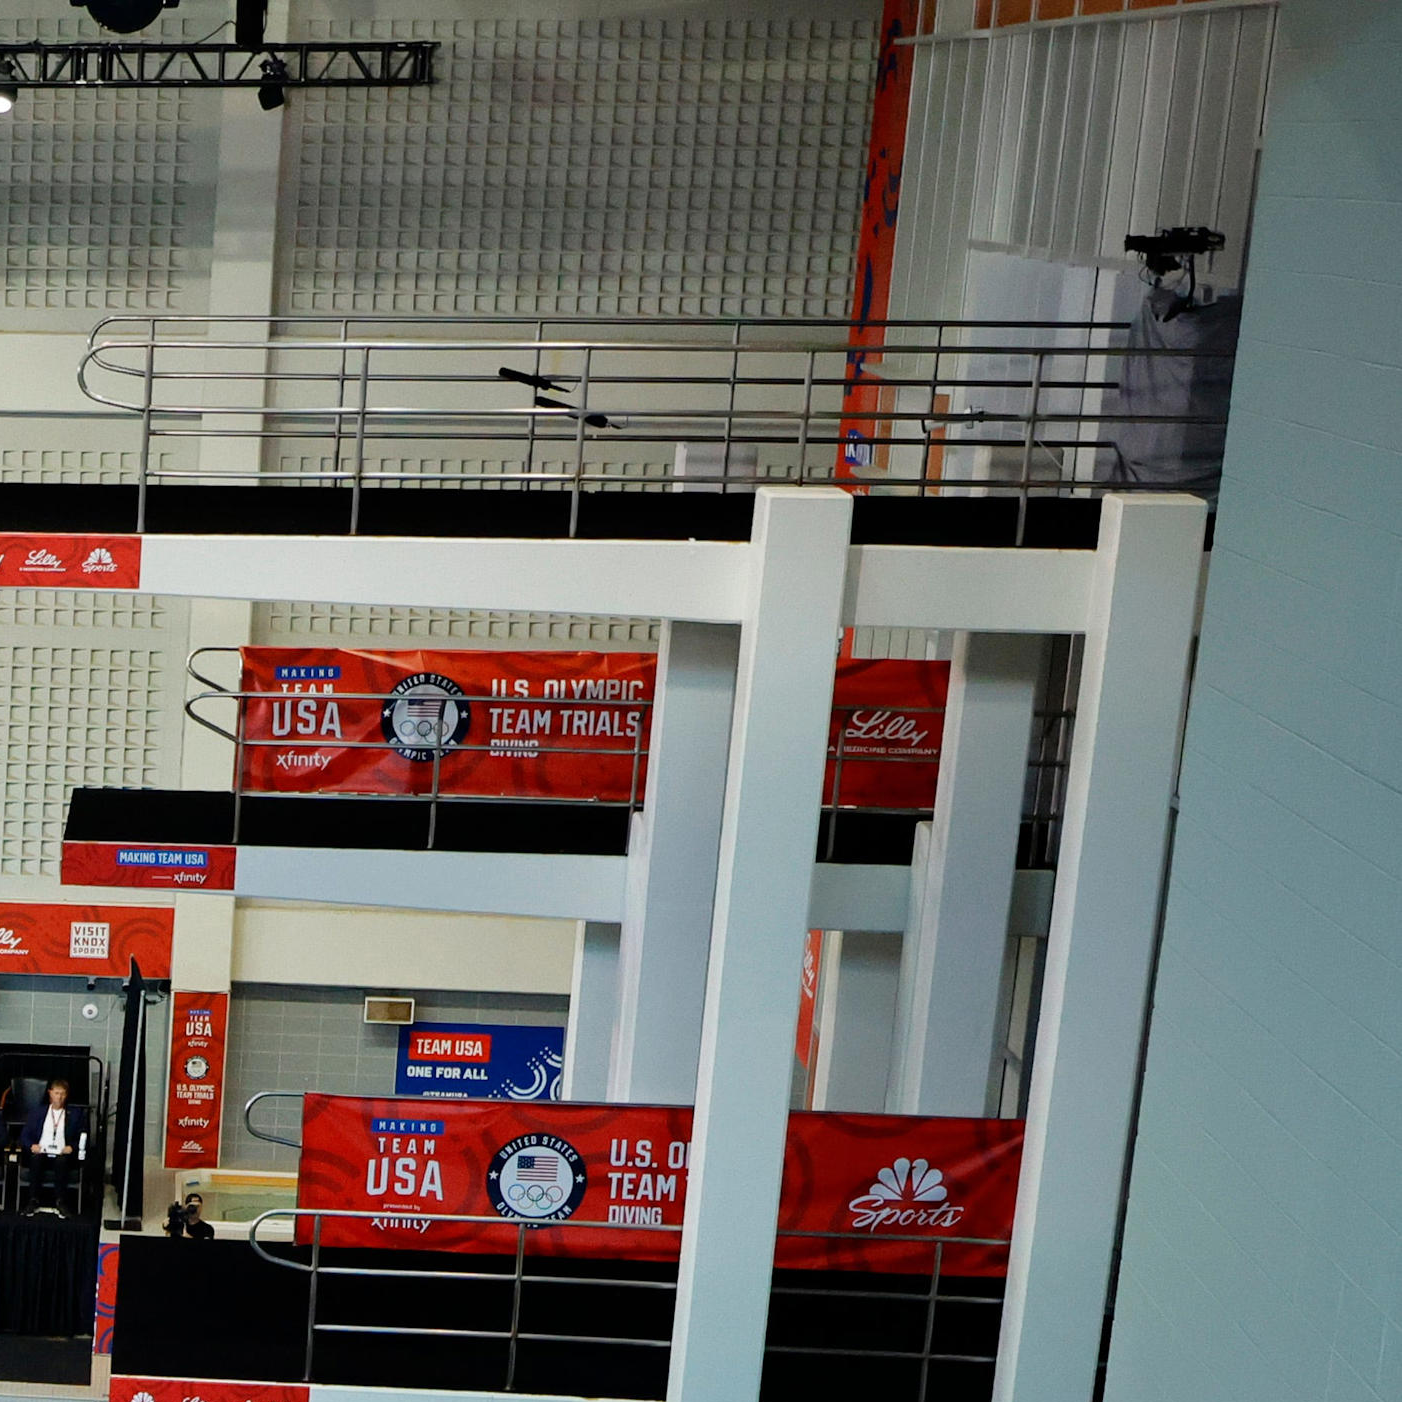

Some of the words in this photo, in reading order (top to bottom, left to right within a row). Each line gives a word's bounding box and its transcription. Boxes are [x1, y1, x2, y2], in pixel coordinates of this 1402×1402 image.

[24, 548, 63, 567] Lilly
[81, 560, 118, 574] Sports
[281, 668, 335, 678] MAKING
[281, 684, 334, 695] TEAM
[271, 699, 342, 739] USA
[488, 708, 551, 736] TEAM
[559, 709, 640, 738] TRIALS
[845, 709, 929, 747] Lilly
[276, 750, 332, 771] xfinity
[119, 851, 155, 864] MAKING
[157, 852, 182, 865] TEAM
[184, 854, 204, 866] USA
[173, 872, 207, 884] xfinity
[74, 925, 107, 936] VISIT
[72, 947, 105, 955] SPORTS
[73, 937, 107, 947] KNOX
[185, 1022, 213, 1037] USA
[416, 1038, 452, 1055] TEAM
[454, 1040, 483, 1057] USA
[406, 1065, 433, 1078] ONE
[435, 1066, 461, 1079] FOR
[462, 1068, 489, 1081] ALL
[178, 1116, 210, 1129] xfinity
[378, 1120, 437, 1133] MAKING
[377, 1137, 436, 1155] TEAM
[499, 1135, 537, 1160] UNITED
[542, 1135, 579, 1163] STATES
[609, 1138, 657, 1168] U.S.
[366, 1157, 443, 1201] USA
[607, 1172, 676, 1202] TEAM
[608, 1205, 663, 1225] DIVING
[848, 1194, 965, 1233] Sports
